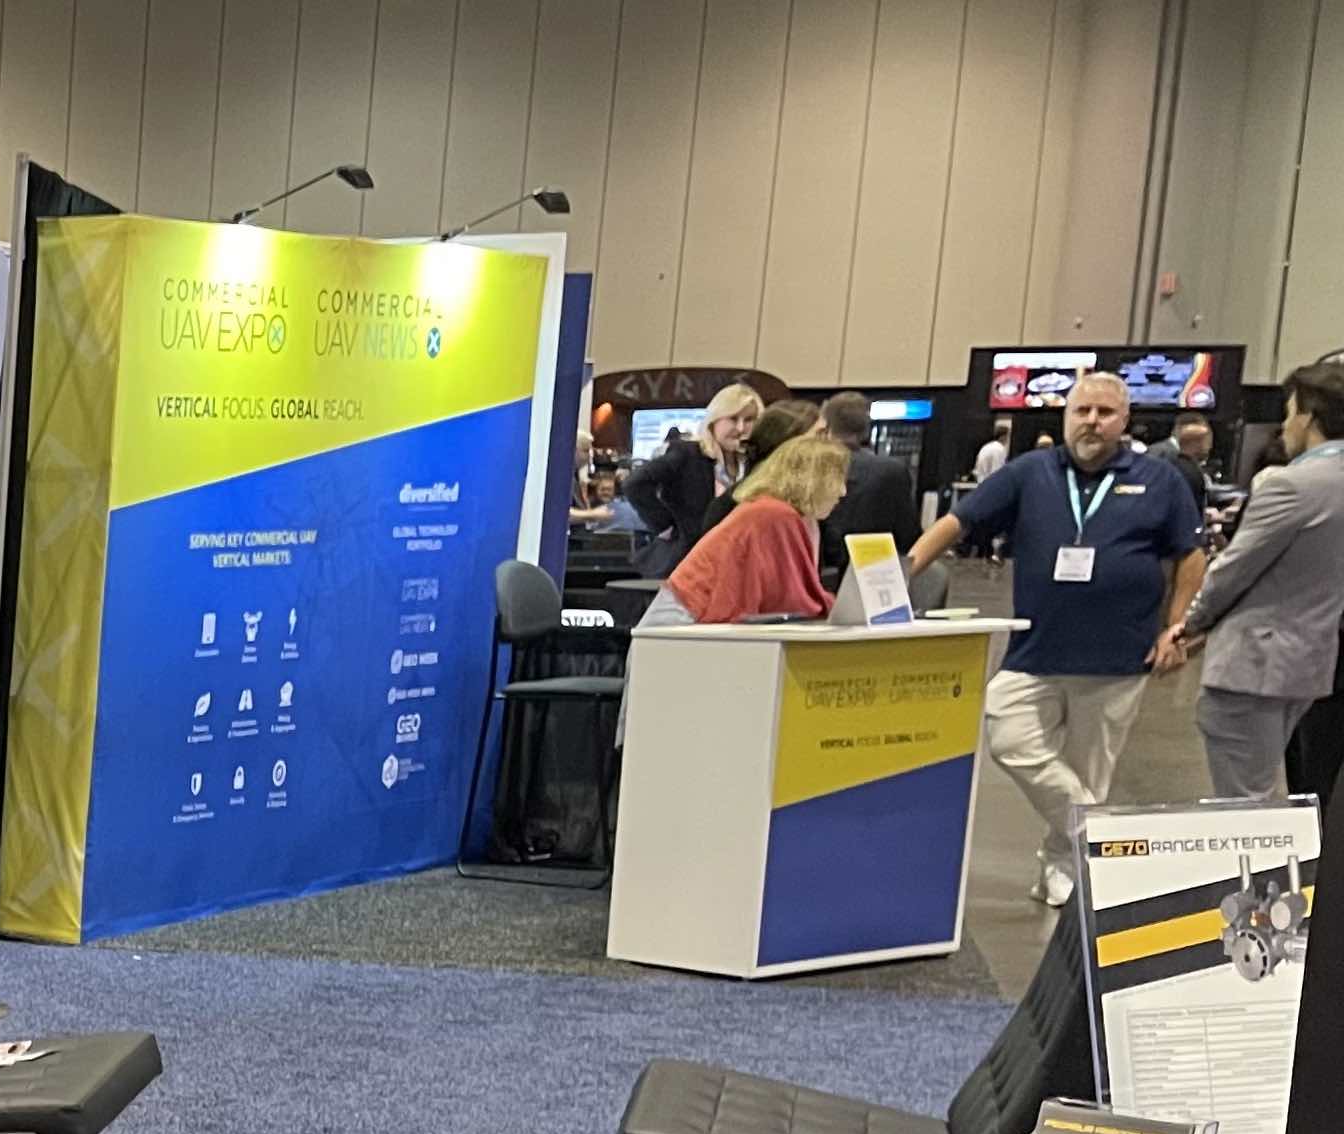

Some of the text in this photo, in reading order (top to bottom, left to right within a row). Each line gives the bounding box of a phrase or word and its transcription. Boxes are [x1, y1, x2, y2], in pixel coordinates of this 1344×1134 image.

[163, 278, 290, 309] COMMERCIAL
[313, 320, 420, 360] UAV NEWS
[157, 396, 218, 419] VERTICAL
[270, 396, 320, 420] GLOBAL
[399, 481, 459, 503] diversified
[189, 529, 317, 549] SERVING KEY COMMERCIAL UAV
[213, 550, 291, 568] VERTICAL MARKETS
[1151, 838, 1205, 852] RANGE
[1208, 834, 1294, 851] EXTENDER
